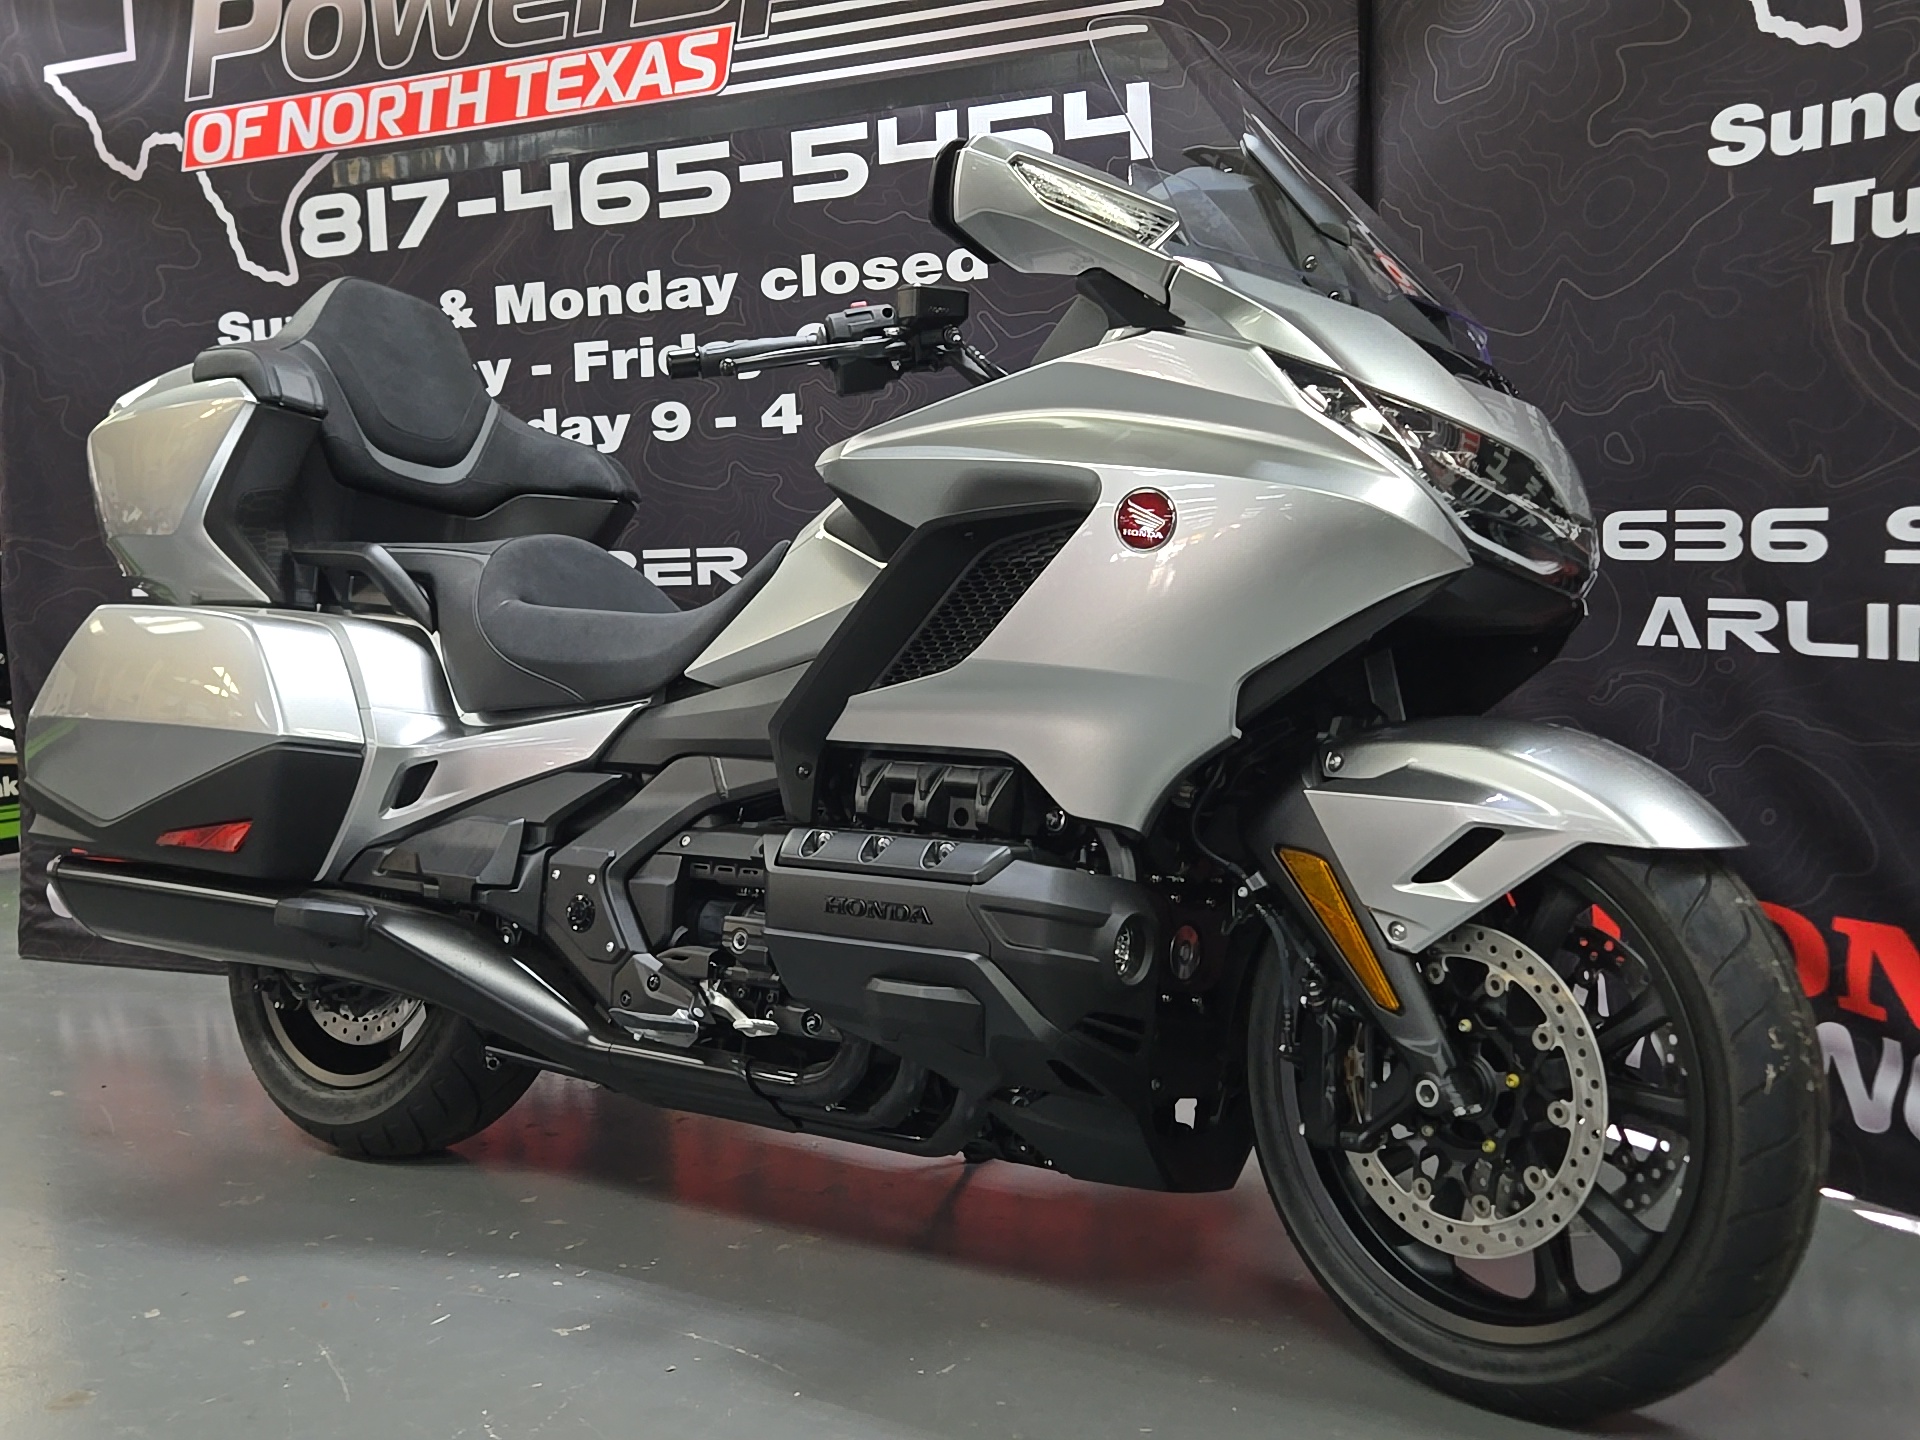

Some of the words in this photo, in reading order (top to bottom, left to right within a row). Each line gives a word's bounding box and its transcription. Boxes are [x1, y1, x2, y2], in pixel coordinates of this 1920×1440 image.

[191, 112, 268, 164] OF
[278, 69, 491, 152] NORTH
[504, 31, 720, 118] TEXAS
[299, 81, 1154, 259] 817-465-5454
[439, 289, 477, 329] &
[494, 269, 738, 325] Monday
[760, 247, 989, 301] closed
[651, 400, 691, 442] 9
[760, 392, 803, 434] 4
[1122, 528, 1164, 540] HONDA
[1602, 506, 1830, 563] 636
[824, 895, 933, 925] HONDA
